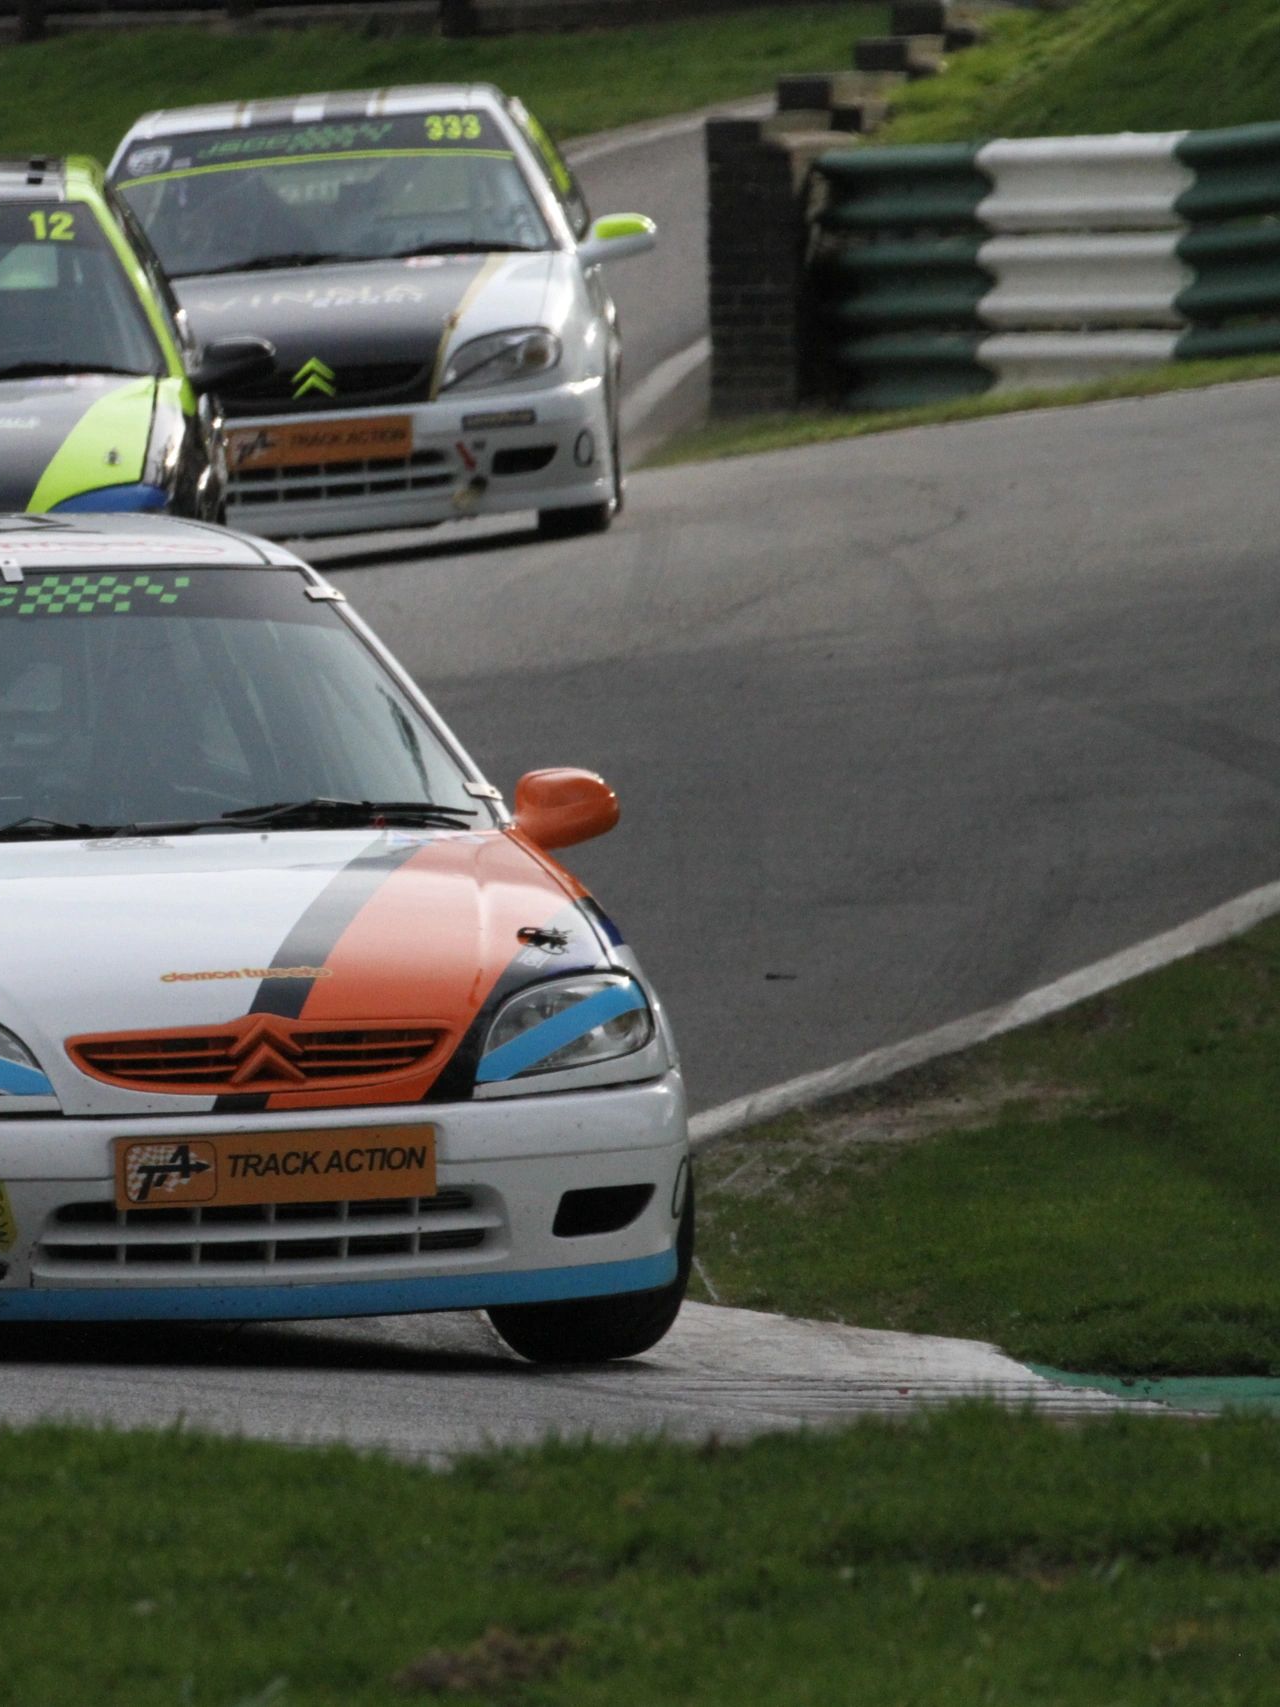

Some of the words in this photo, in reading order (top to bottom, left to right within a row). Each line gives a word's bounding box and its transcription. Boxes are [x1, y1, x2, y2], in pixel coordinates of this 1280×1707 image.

[424, 113, 481, 141] 333
[27, 210, 75, 241] 12
[160, 969, 240, 983] demon
[227, 1151, 321, 1178] TRACK
[323, 1146, 428, 1174] ACTION
